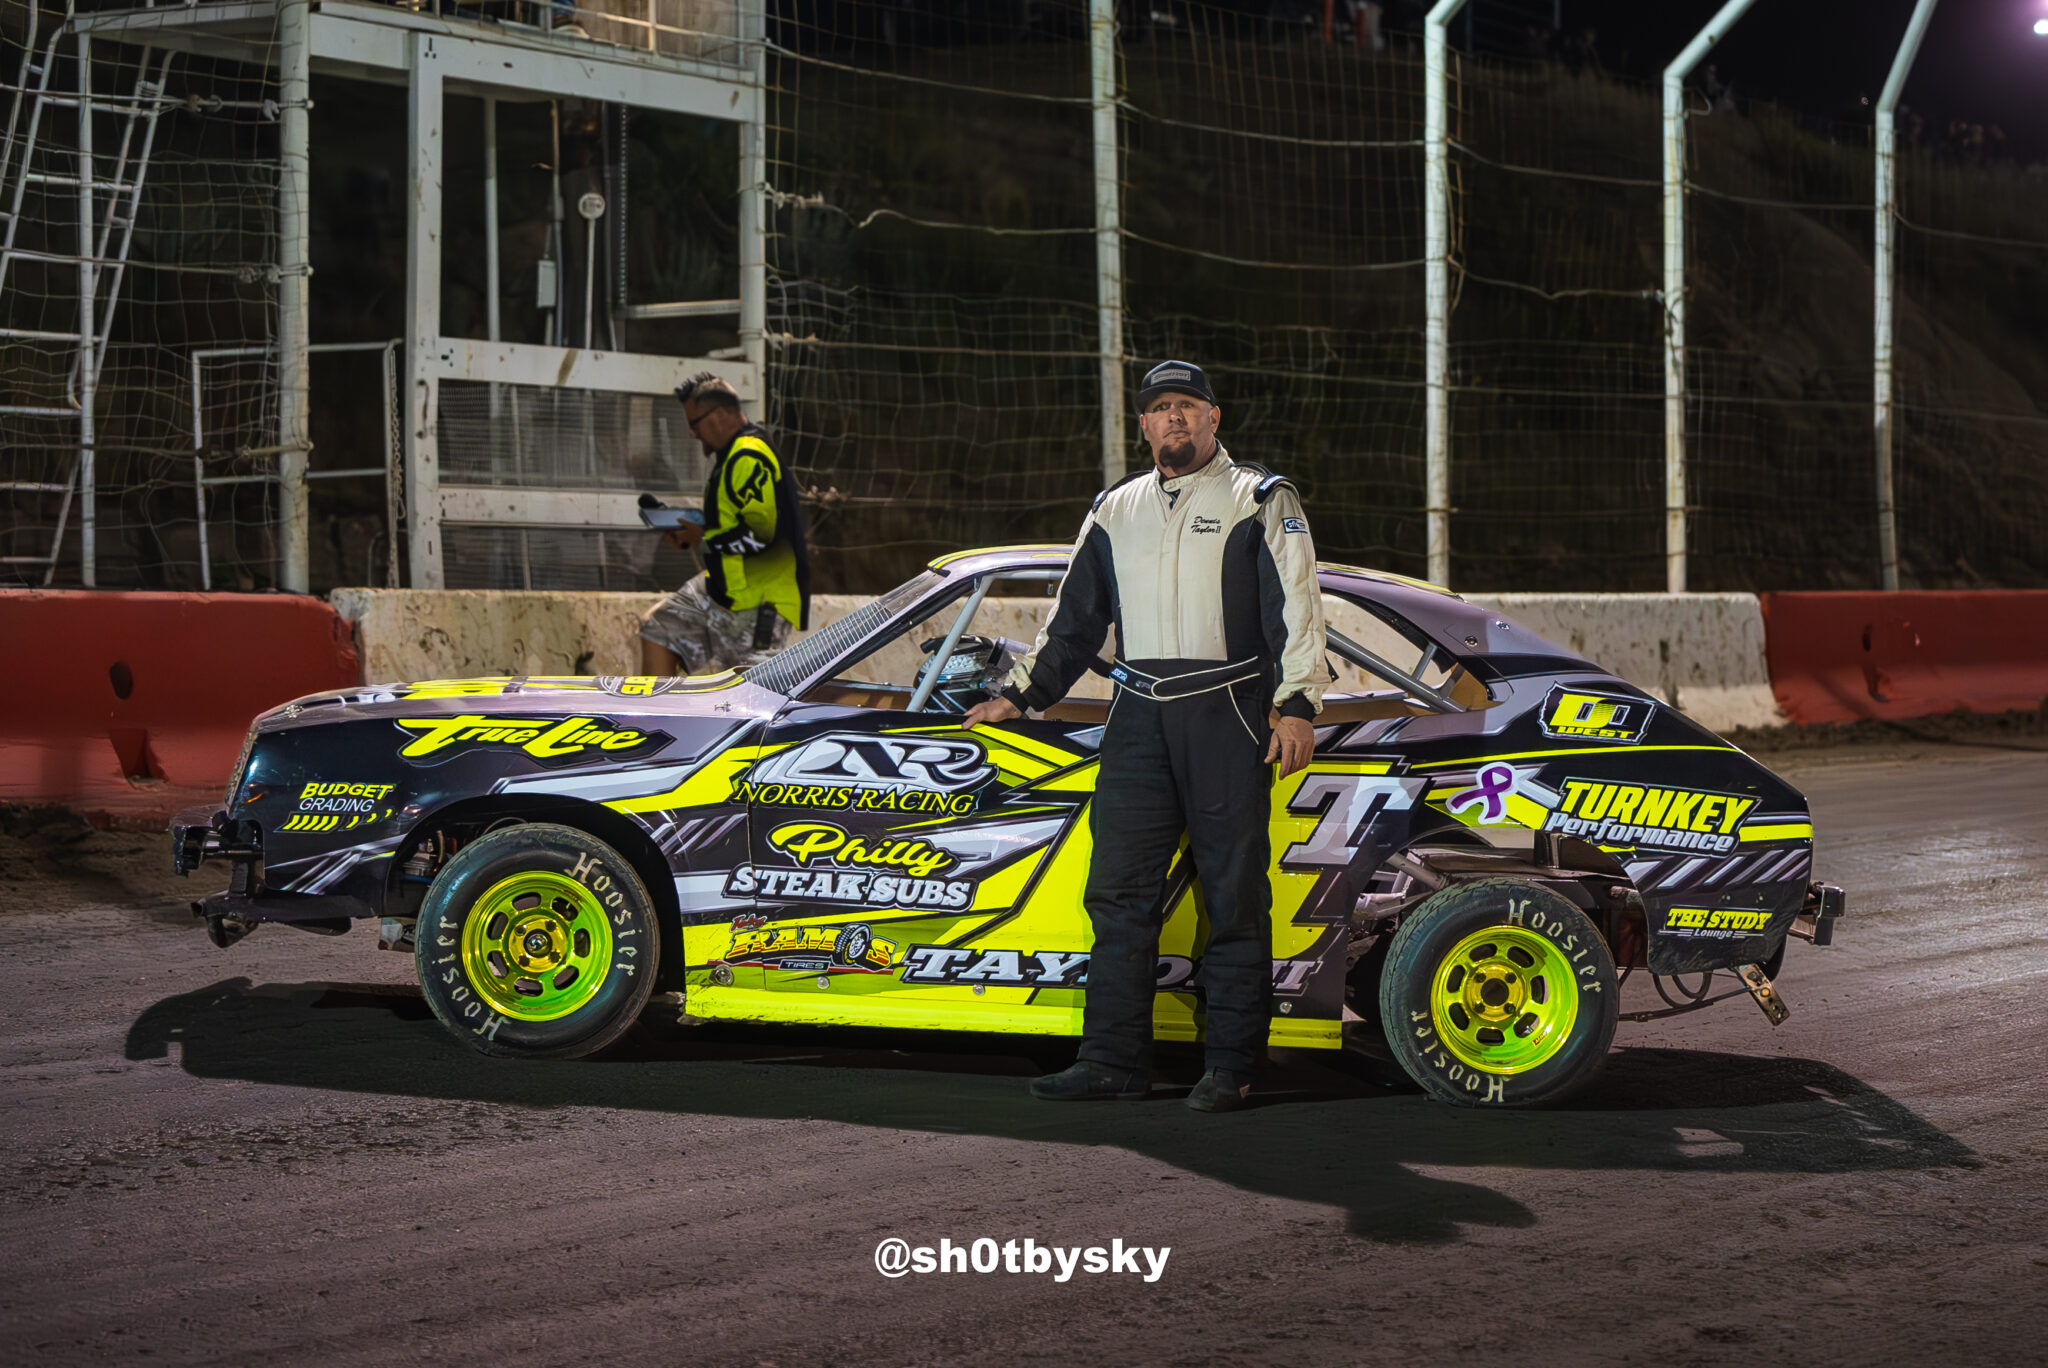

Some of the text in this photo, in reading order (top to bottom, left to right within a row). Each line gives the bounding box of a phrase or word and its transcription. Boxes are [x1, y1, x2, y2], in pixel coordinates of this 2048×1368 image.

[1191, 524, 1215, 535] Taylor
[1193, 515, 1221, 524] Dennis
[1557, 726, 1635, 739] WEST
[299, 783, 393, 801] BUDGET
[299, 796, 374, 813] GRADING
[734, 781, 975, 814] NORRIS RACING
[1562, 780, 1755, 836] TURNKEY
[770, 823, 954, 876] Philly
[1544, 811, 1735, 852] Performance
[730, 865, 971, 908] STEAK SUBS
[564, 851, 643, 978] Hoosier
[1666, 908, 1773, 930] THE STUDY
[1508, 898, 1602, 994] Hoosier
[1693, 928, 1733, 940] Lounge
[432, 915, 512, 1042] Hoosier
[1410, 1010, 1505, 1103] Hoosier
